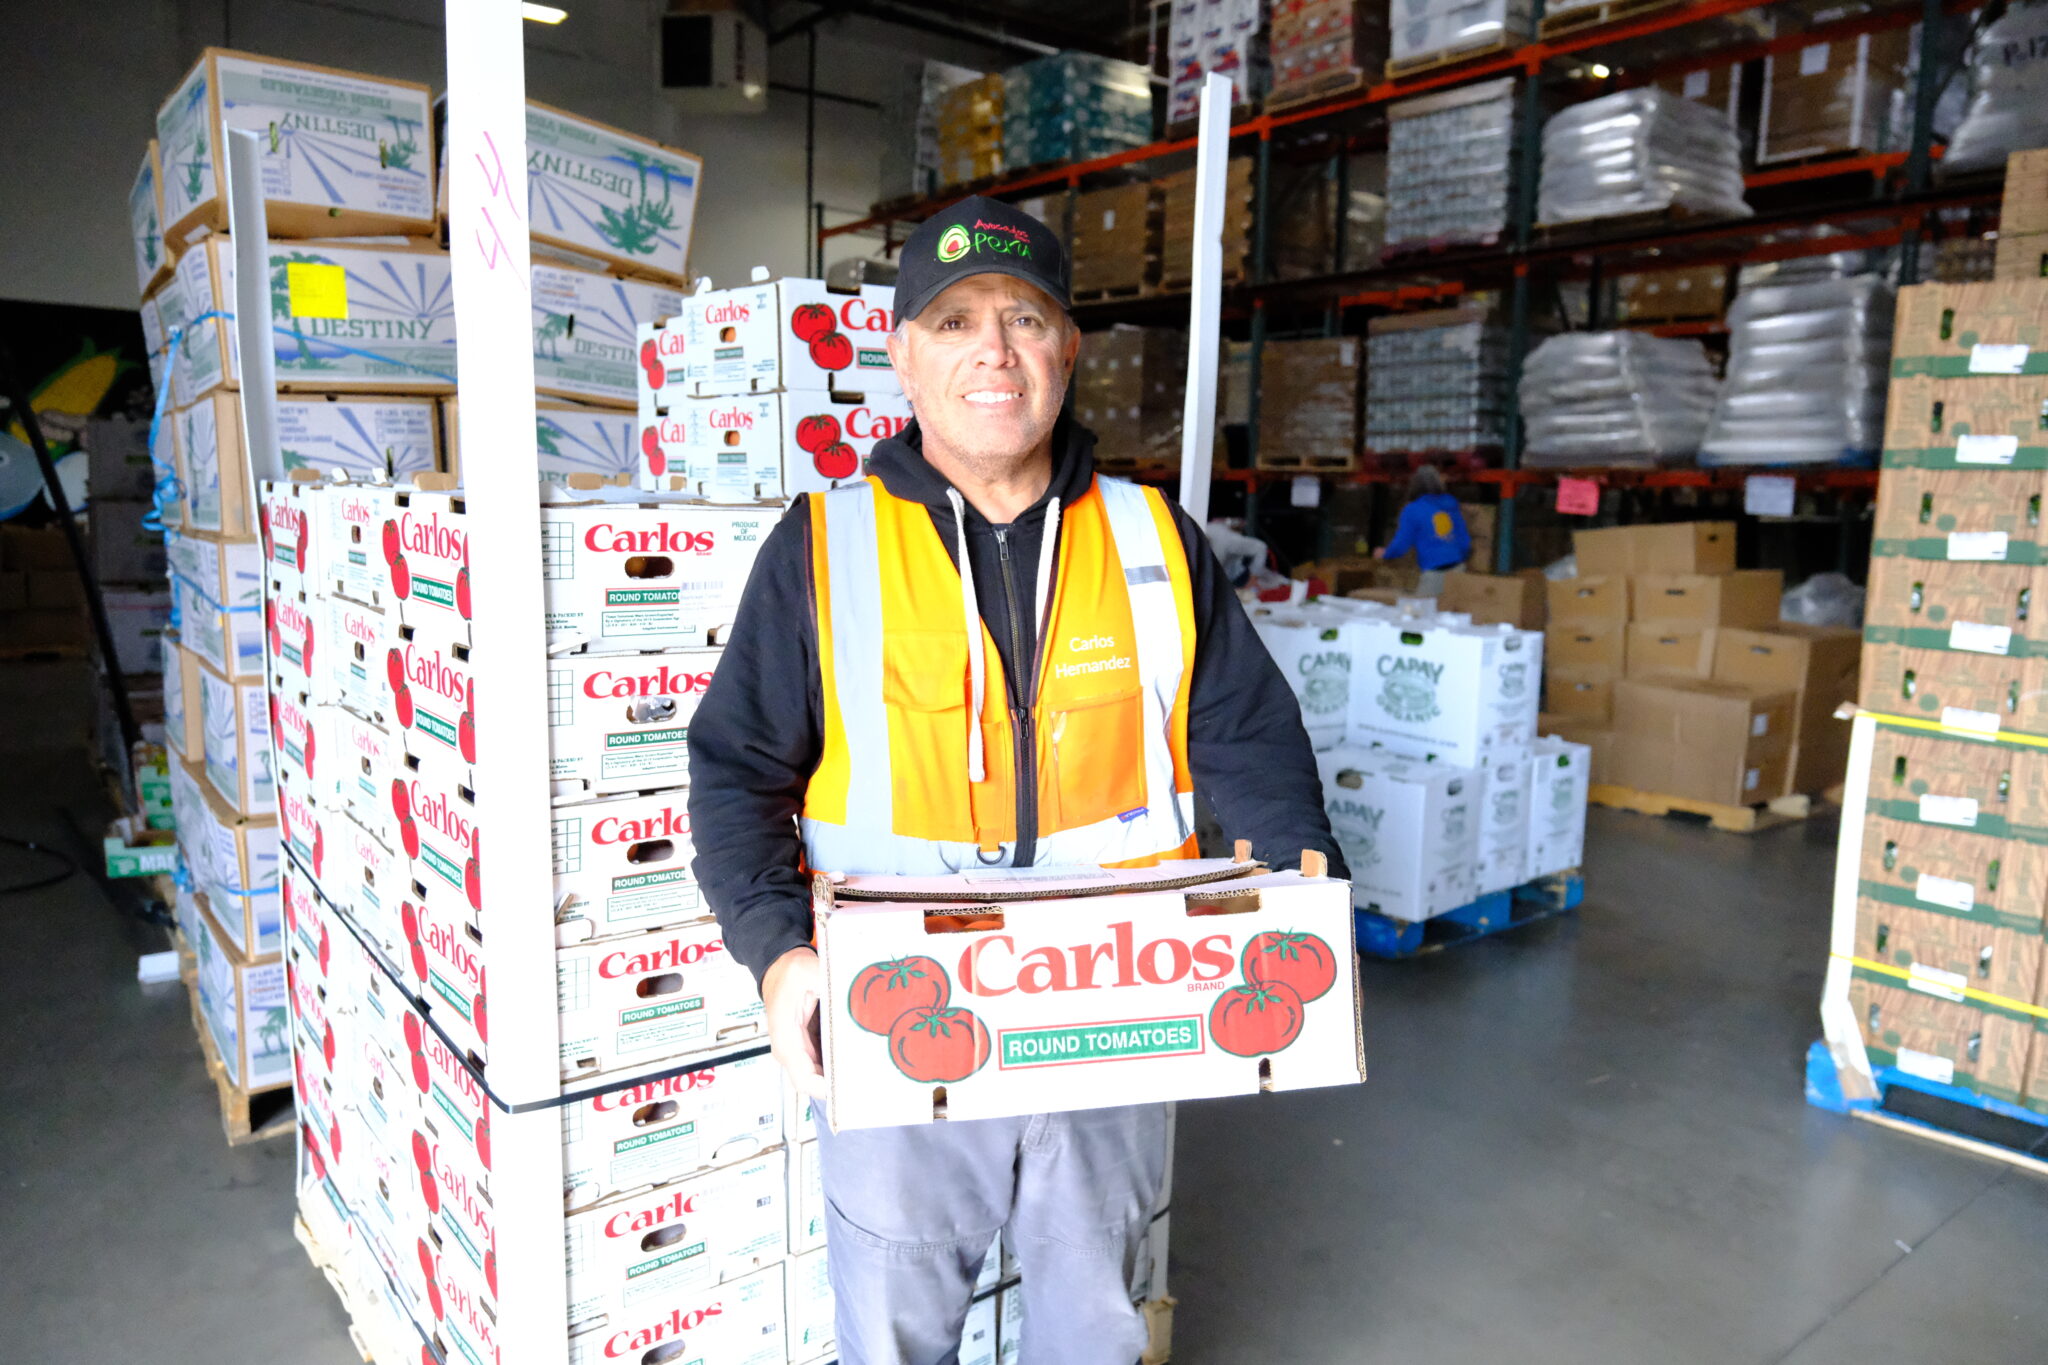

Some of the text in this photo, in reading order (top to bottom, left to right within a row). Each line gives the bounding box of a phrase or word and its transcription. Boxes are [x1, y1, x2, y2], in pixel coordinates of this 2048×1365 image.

[280, 112, 375, 141] DESTINY
[527, 150, 633, 198] DESTINY
[975, 233, 1032, 260] Peru
[705, 300, 750, 325] Carlos
[311, 318, 434, 339] DESTINY
[709, 406, 753, 430] Carlos
[269, 497, 300, 536] Carlos
[342, 498, 370, 525] Carlos
[401, 511, 461, 560] Carlos
[584, 522, 714, 552] Carlos
[609, 592, 641, 603] ROUND
[276, 595, 305, 638] Carlos
[1069, 635, 1115, 652] Carlos
[405, 643, 464, 703] Carlos
[583, 666, 714, 699] Carlos
[1055, 656, 1131, 679] Hernandez
[1377, 655, 1444, 684] CAPAY
[609, 730, 687, 745] ROUND TOMATOES
[411, 780, 470, 849] Carlos
[1327, 797, 1385, 831] APAY
[613, 877, 646, 888] ROUND
[418, 905, 479, 984] Carlos
[598, 939, 723, 979] Carlos
[957, 921, 1234, 997] Carlos
[1187, 981, 1225, 992] BRAND
[624, 999, 701, 1022] ROUND TOMATOES
[1009, 1026, 1192, 1057] ROUND TOMATOES
[617, 1123, 693, 1151] ROUND TOMATOES
[433, 1144, 489, 1240] Carlos
[628, 1257, 659, 1277] ROUND
[660, 1242, 704, 1266] TOMATOES
[604, 1301, 723, 1358] Carlos
